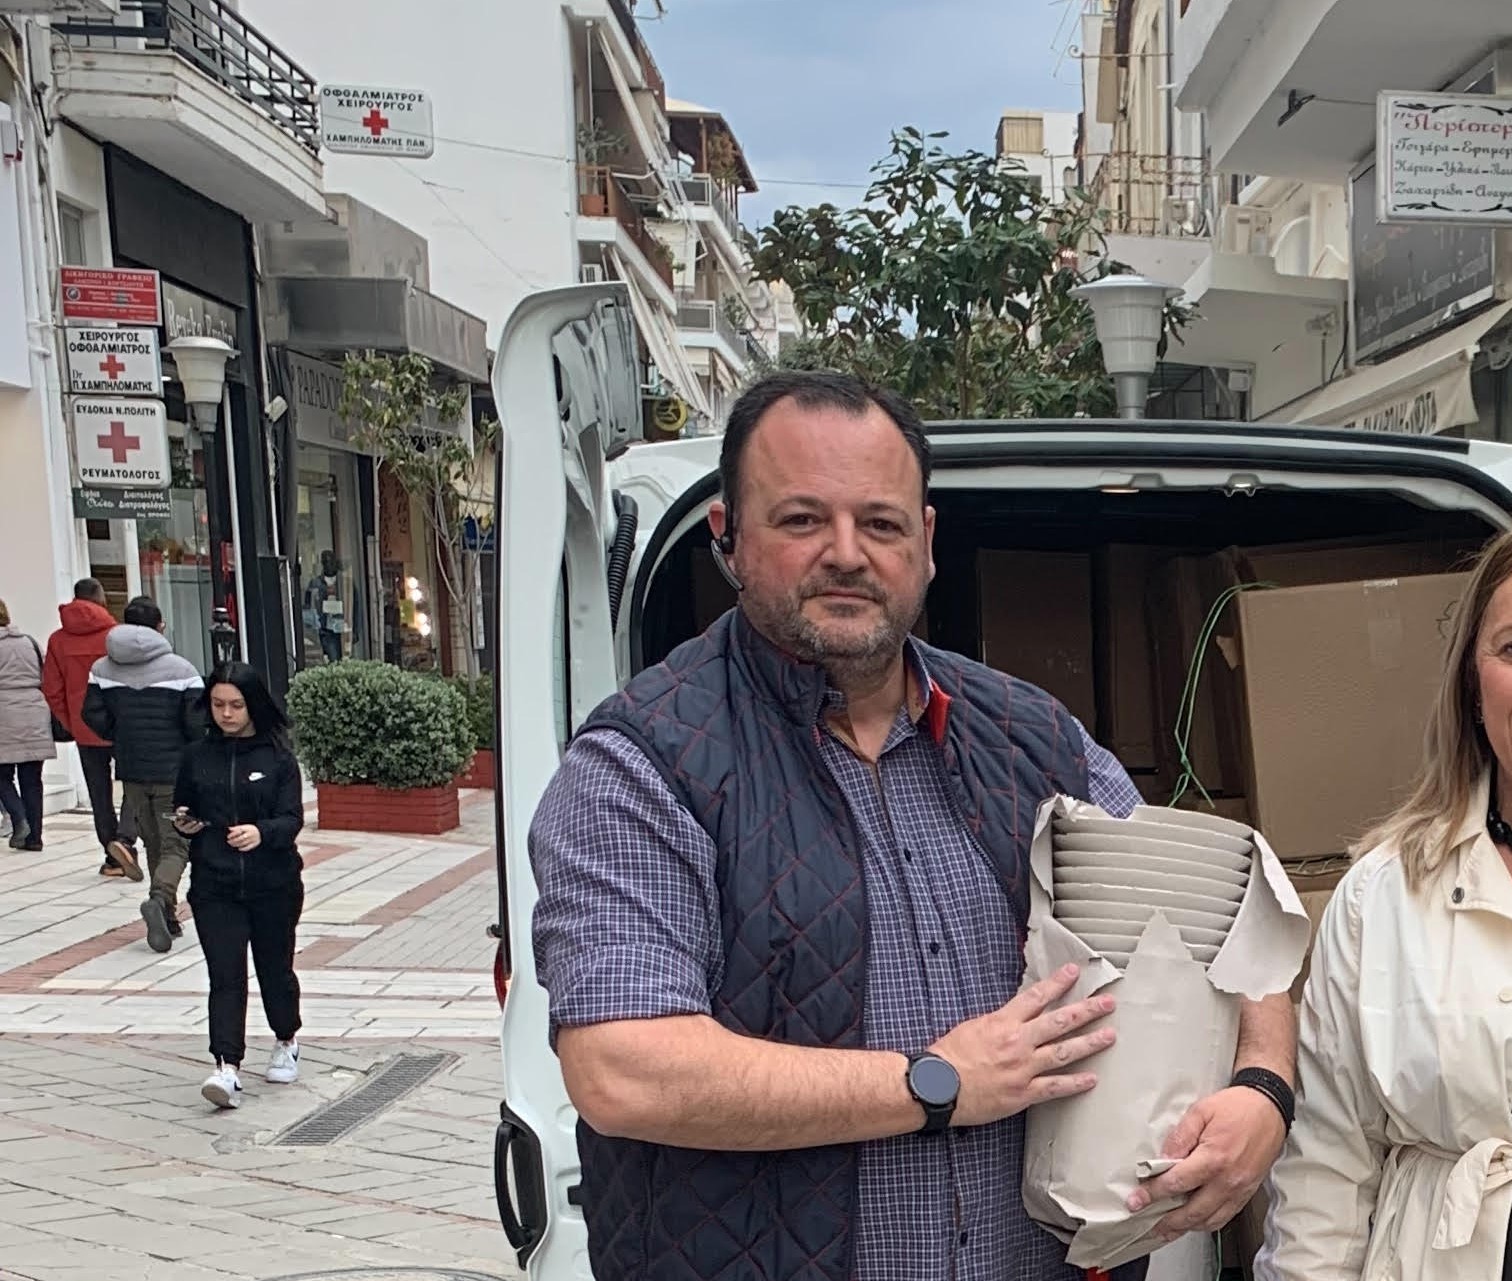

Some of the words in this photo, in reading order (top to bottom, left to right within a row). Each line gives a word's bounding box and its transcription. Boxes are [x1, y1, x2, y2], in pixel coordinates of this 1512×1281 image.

[323, 88, 424, 102] ΟΦΘΑΛΜΙΑΤΡΟΣ
[338, 99, 413, 111] ΧΕΙΡΟΥΡΓΟΣ
[79, 331, 139, 342] ΧΕΙΡΟΥΡΓΟΣ
[69, 342, 151, 354] ΟΦΘΑΛΜΙΑΤΡΟΣ
[72, 369, 83, 379] Dr
[76, 405, 113, 414] ΕΥΔΟΚΙΑ
[82, 468, 160, 479] ΡΕΥΜΑΤΟΛΟΓΟΣ
